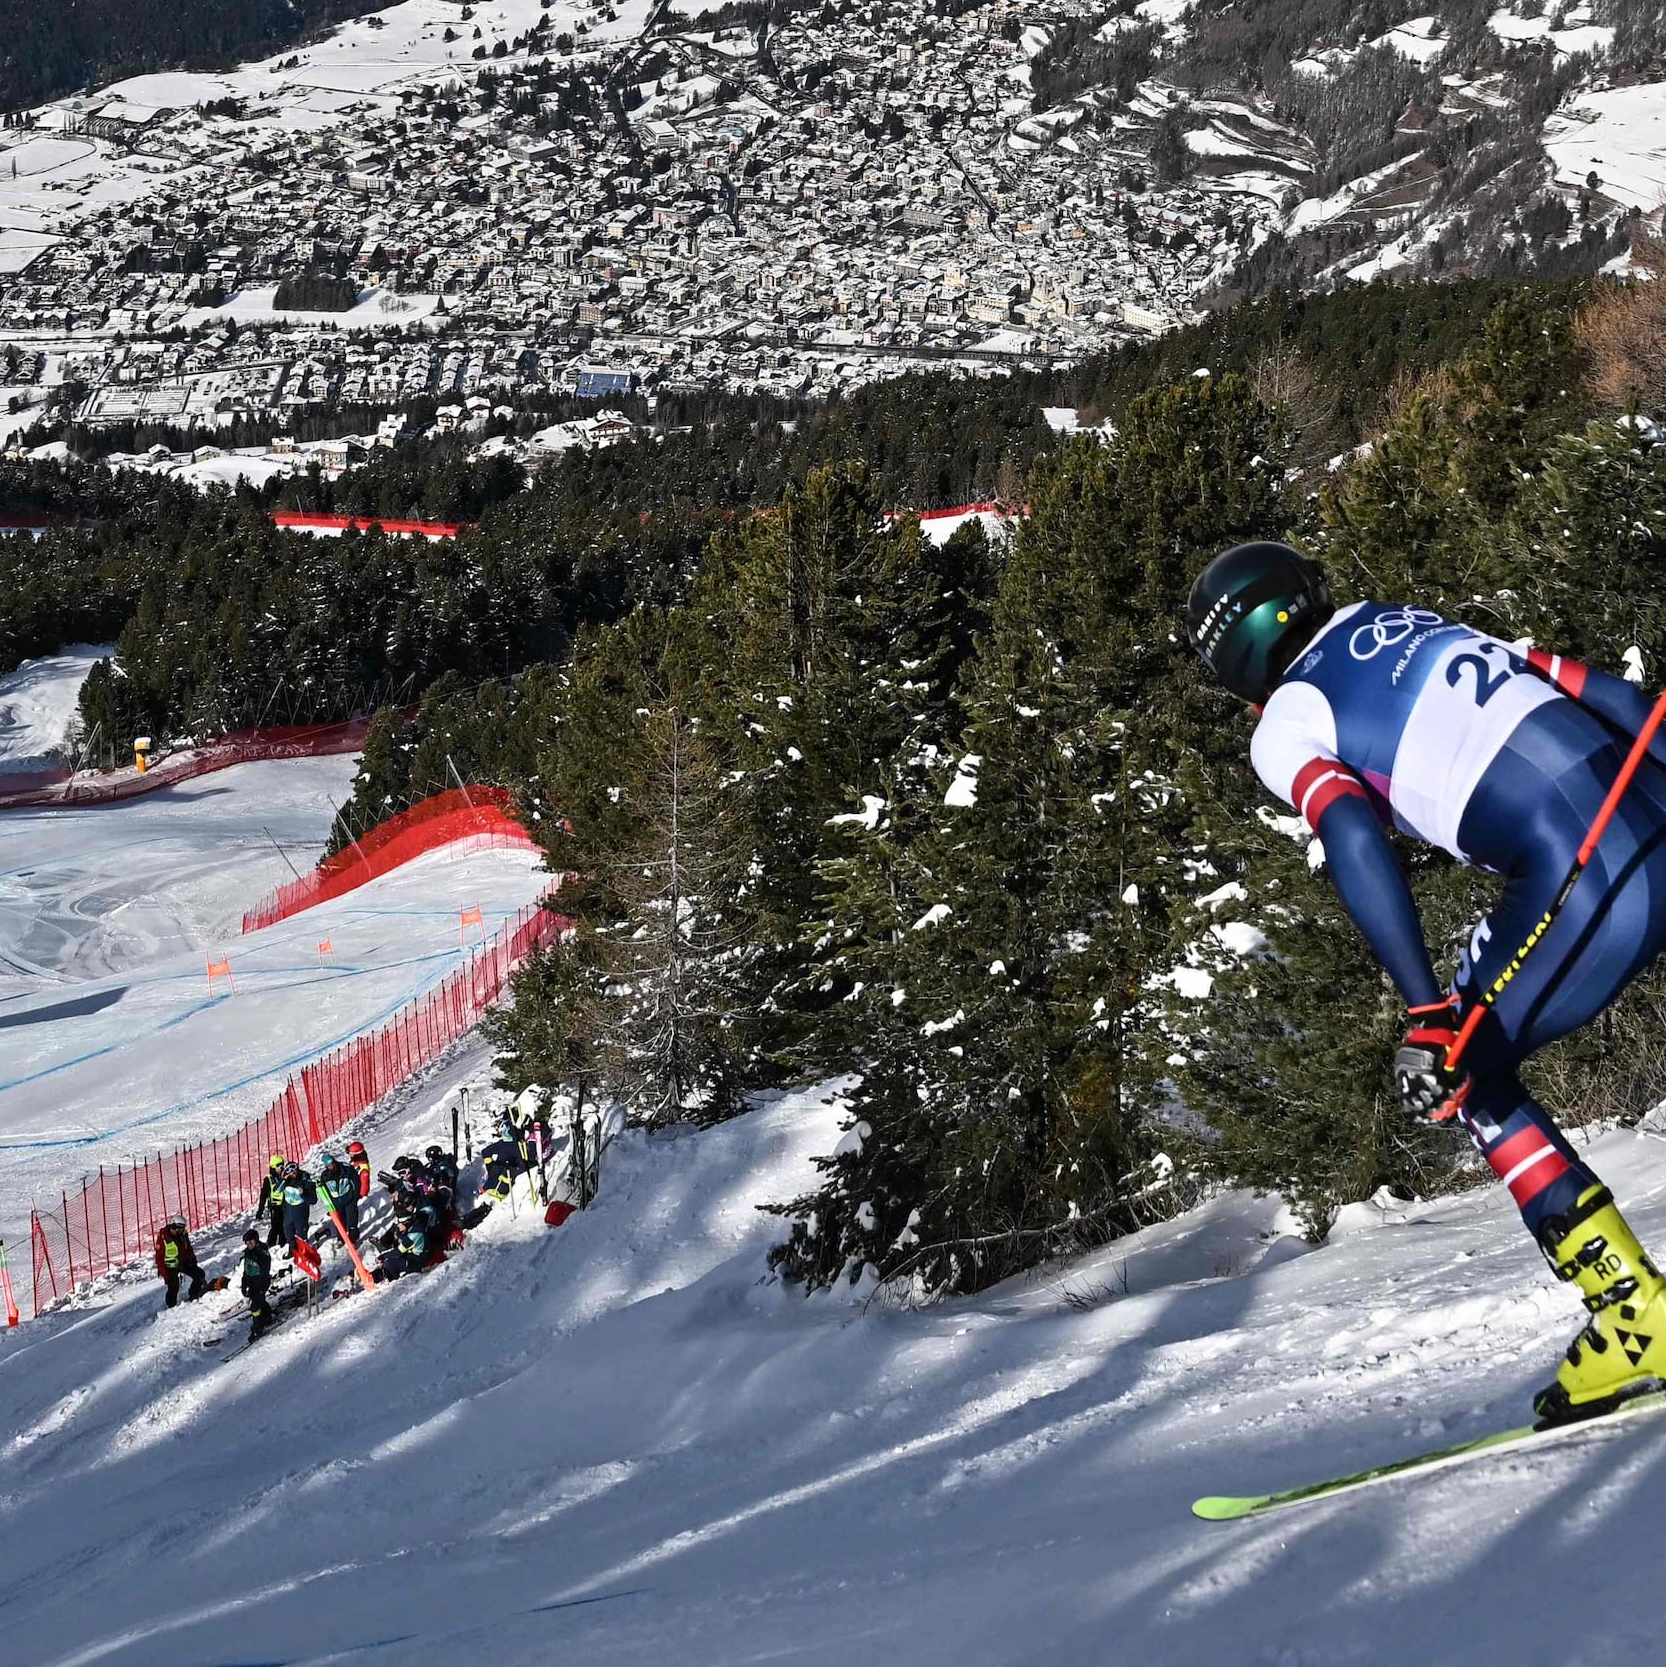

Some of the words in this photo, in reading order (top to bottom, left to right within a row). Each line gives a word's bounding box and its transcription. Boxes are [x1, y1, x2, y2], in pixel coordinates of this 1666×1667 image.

[1205, 601, 1243, 658] OAKLEY
[1391, 634, 1427, 686] MILANO
[1592, 1254, 1623, 1281] RD
